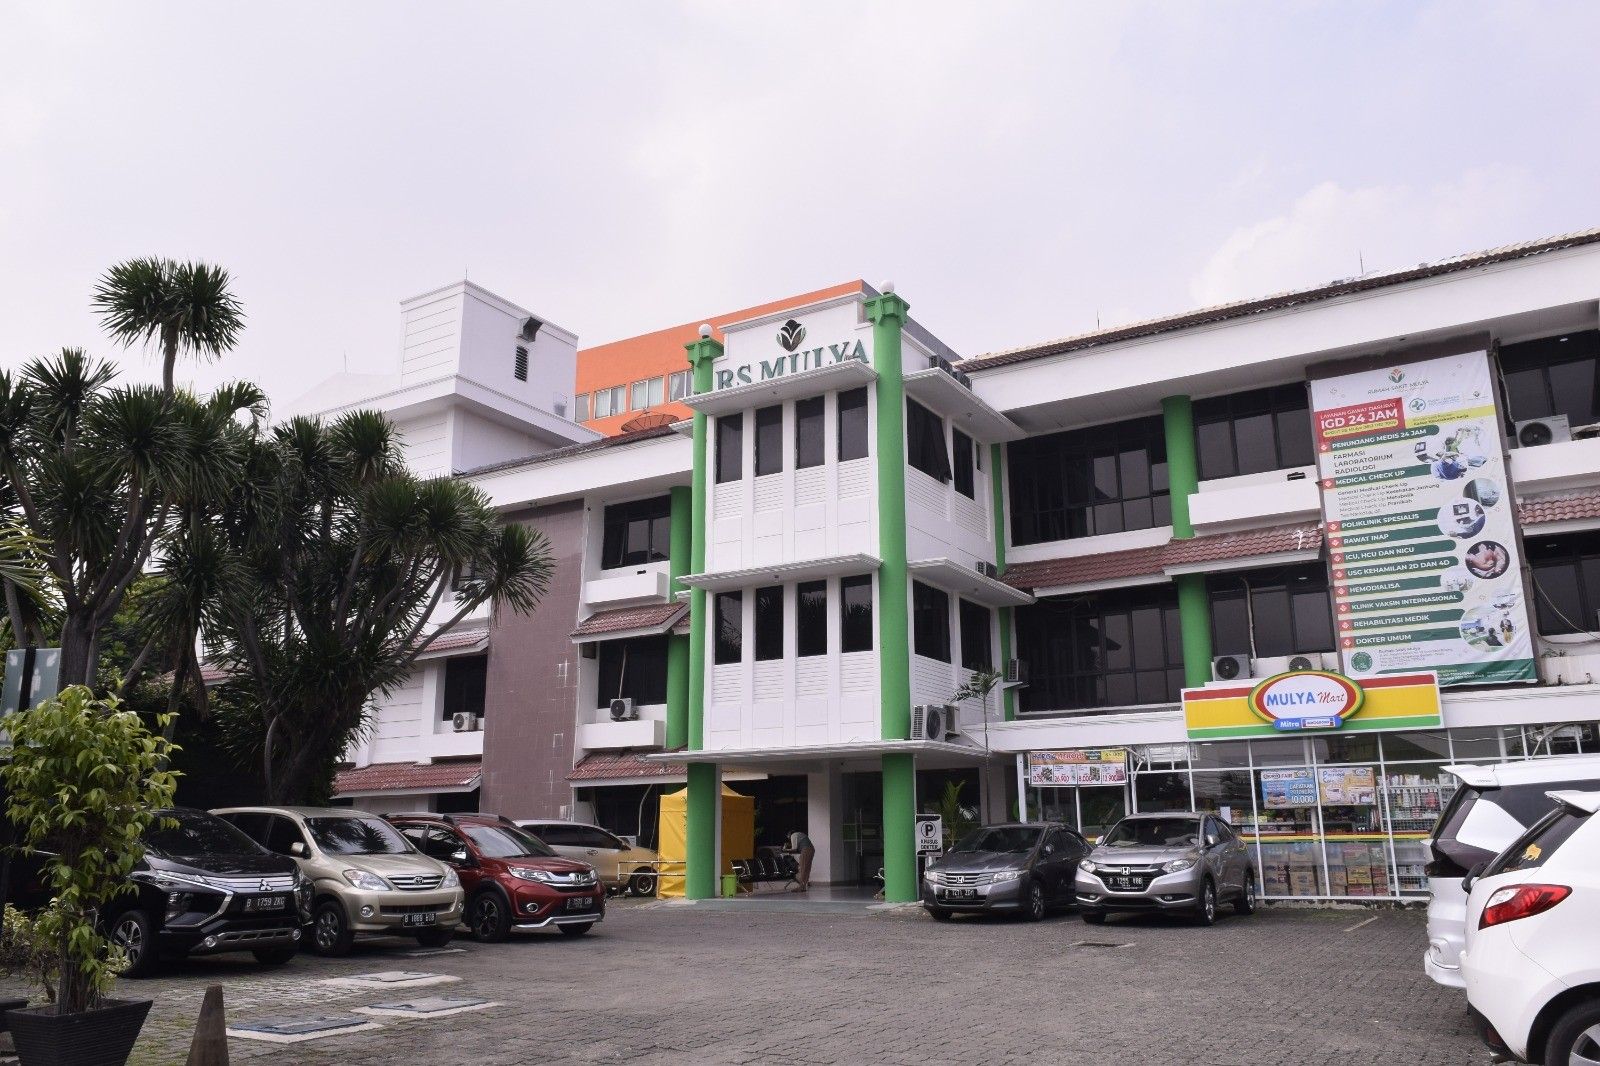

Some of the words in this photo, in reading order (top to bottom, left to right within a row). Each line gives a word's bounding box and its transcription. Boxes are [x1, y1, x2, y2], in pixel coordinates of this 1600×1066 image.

[716, 364, 752, 391] RS
[759, 338, 870, 381] MULYA
[1320, 417, 1345, 430] IGD
[1347, 413, 1366, 425] 24
[1368, 408, 1398, 422] JAM
[1332, 437, 1375, 449] PENUNJANG
[1376, 432, 1400, 443] MEDIS
[1410, 428, 1427, 437] JAM
[1333, 450, 1366, 460] FARMASI
[1334, 454, 1393, 468] LABORATORIUM
[1335, 464, 1376, 475] RADIOLOGI
[1335, 476, 1367, 485] MEDICAL
[1368, 472, 1393, 481] CHECK
[1338, 488, 1359, 496] General
[1341, 519, 1382, 529] POLIKLINIK
[1383, 513, 1420, 523] SPESIALIS
[1343, 536, 1370, 545] RAWAT
[1371, 533, 1389, 541] INAP
[1378, 548, 1395, 556] DAN
[1395, 546, 1415, 554] NICU
[1364, 564, 1407, 574] KEHAMILAN
[1349, 582, 1401, 593] HEMODIALISA
[1351, 602, 1374, 610] KLINIK
[1374, 600, 1400, 608] VAKSIN
[1401, 594, 1458, 605] INTERNASIONAL
[1353, 618, 1404, 628] REHABILITASI
[1404, 614, 1430, 623] MEDIK
[1355, 636, 1386, 645] DOKTER
[1387, 634, 1412, 642] UMUM
[1266, 691, 1316, 707] MULYA
[1317, 691, 1345, 704] Mart
[1279, 720, 1300, 728] Mitra
[1032, 753, 1056, 761] HARGA
[925, 824, 934, 836] P
[246, 898, 252, 908] B
